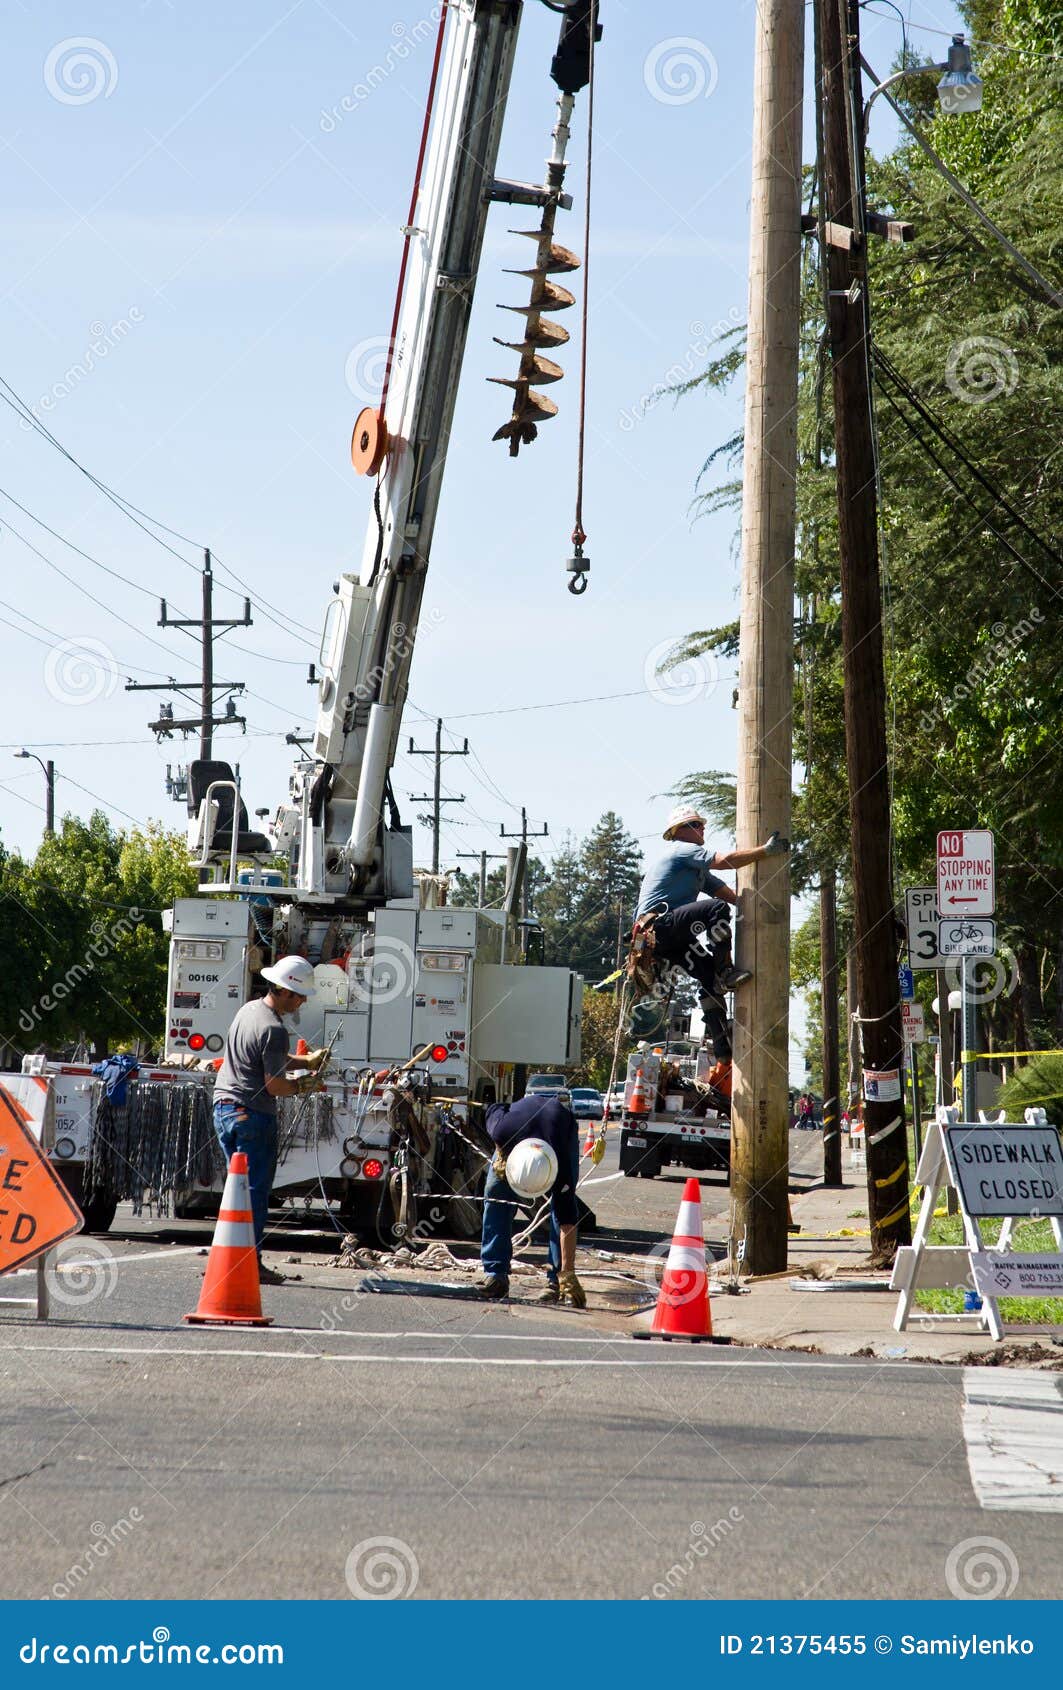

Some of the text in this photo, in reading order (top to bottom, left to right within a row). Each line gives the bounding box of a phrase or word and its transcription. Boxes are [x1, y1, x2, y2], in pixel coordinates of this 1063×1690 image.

[941, 835, 960, 854] NO
[940, 859, 991, 876] STOPPING
[945, 878, 988, 891] ANY TIME
[917, 930, 938, 960] 3
[944, 944, 988, 952] BIKE LANE
[188, 974, 220, 982] 0016K
[904, 1016, 922, 1025] ARKING
[55, 1118, 74, 1131] 052
[961, 1143, 1056, 1164] SIDEWALK
[980, 1179, 1054, 1199] CLOSED
[1016, 1262, 1060, 1270] MANAGEMENT
[1019, 1274, 1036, 1282] 800
